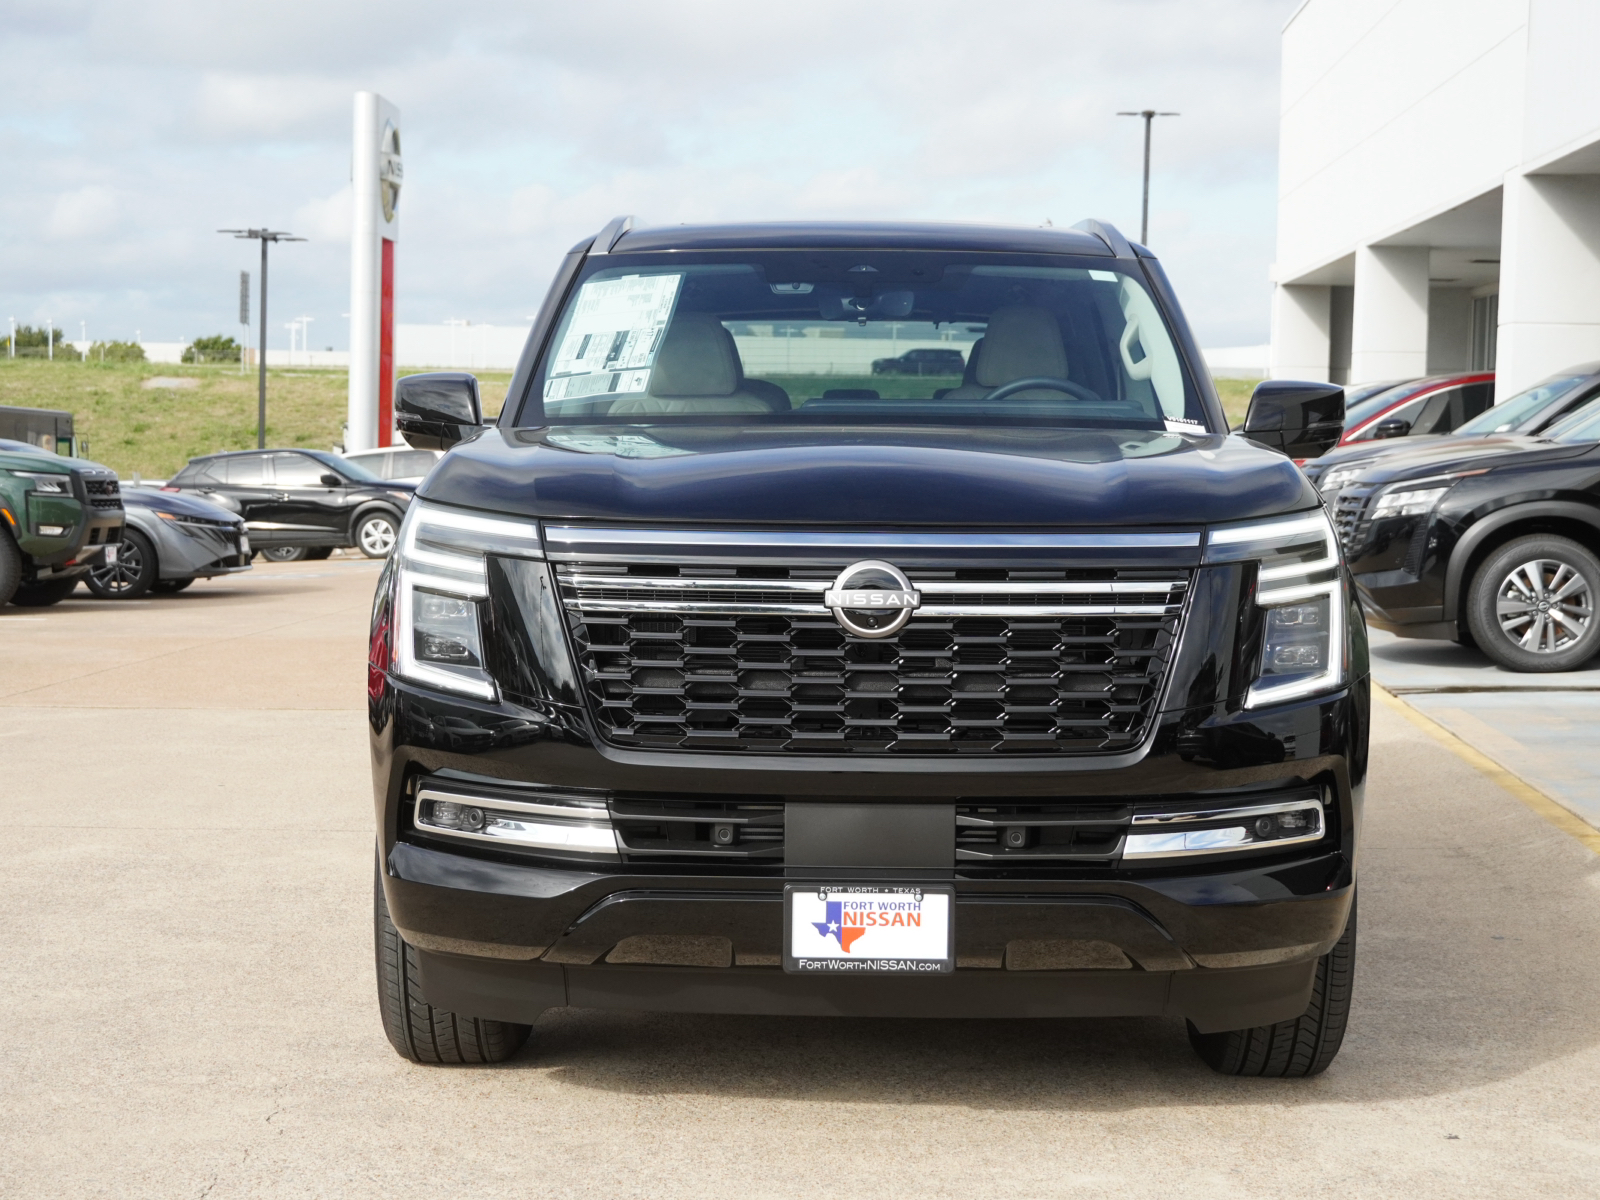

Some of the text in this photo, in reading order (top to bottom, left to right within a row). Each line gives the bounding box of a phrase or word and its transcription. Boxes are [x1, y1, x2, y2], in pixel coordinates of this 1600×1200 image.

[828, 593, 918, 606] NISSAN
[820, 886, 844, 894] FORT
[892, 887, 922, 895] TEXAS
[843, 901, 921, 911] FORT WORTH
[843, 911, 921, 927] NISSAN
